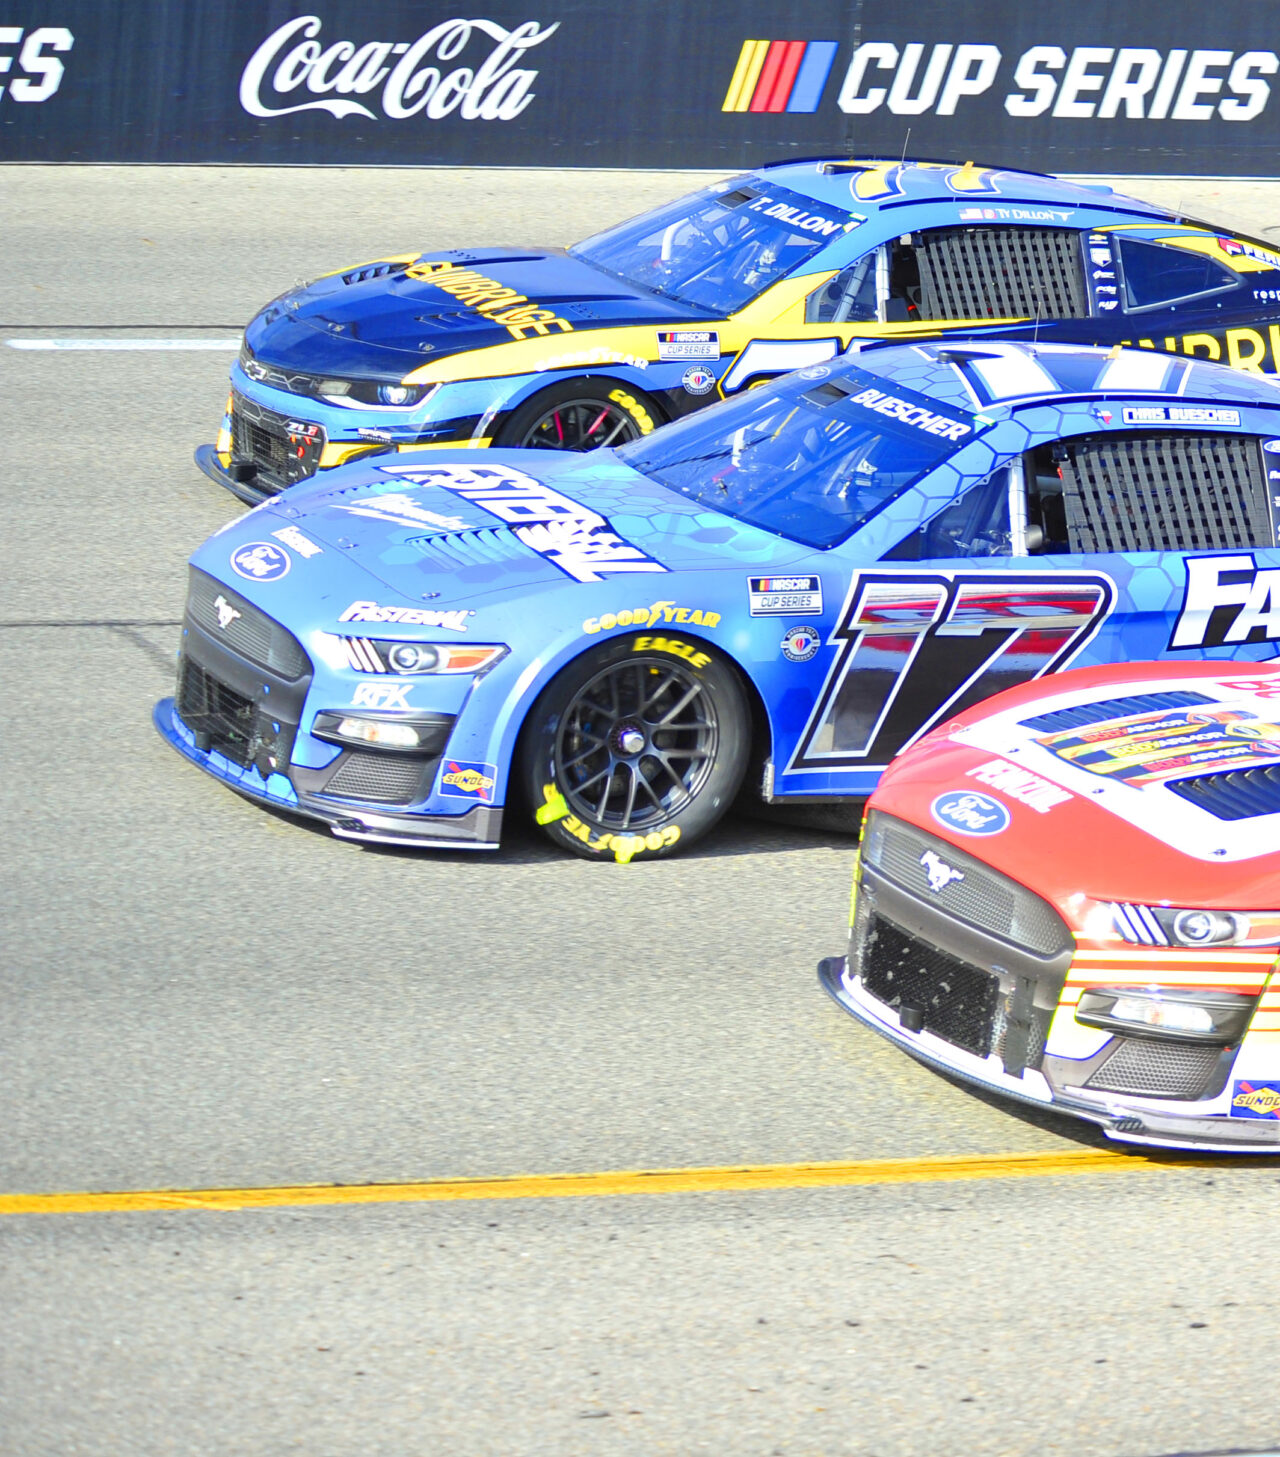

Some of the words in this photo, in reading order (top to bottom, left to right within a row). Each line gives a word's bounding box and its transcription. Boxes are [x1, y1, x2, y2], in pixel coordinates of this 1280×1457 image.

[240, 15, 560, 121] Coca-Cola
[838, 42, 1001, 115] CUP
[1004, 45, 1280, 121] SERIES
[747, 196, 764, 211] T.
[766, 201, 843, 236] DILLON
[1012, 209, 1054, 221] DILLON
[667, 346, 683, 354] CUP
[684, 346, 712, 354] SERIES
[677, 332, 710, 342] NASCAR
[850, 388, 972, 441] BUESCHER
[1122, 408, 1165, 421] CHRIS
[1168, 408, 1239, 423] BUESCHER
[771, 578, 810, 591] NASCAR
[338, 600, 469, 632] FASTENAL
[583, 601, 721, 634] GOODYEAR
[760, 596, 779, 608] CUP
[780, 595, 812, 607] SERIES
[632, 636, 712, 669] EAGLE
[782, 569, 1118, 775] 17
[351, 682, 414, 708] RFK
[543, 782, 680, 854] GOODYER
[938, 793, 1001, 831] Ford
